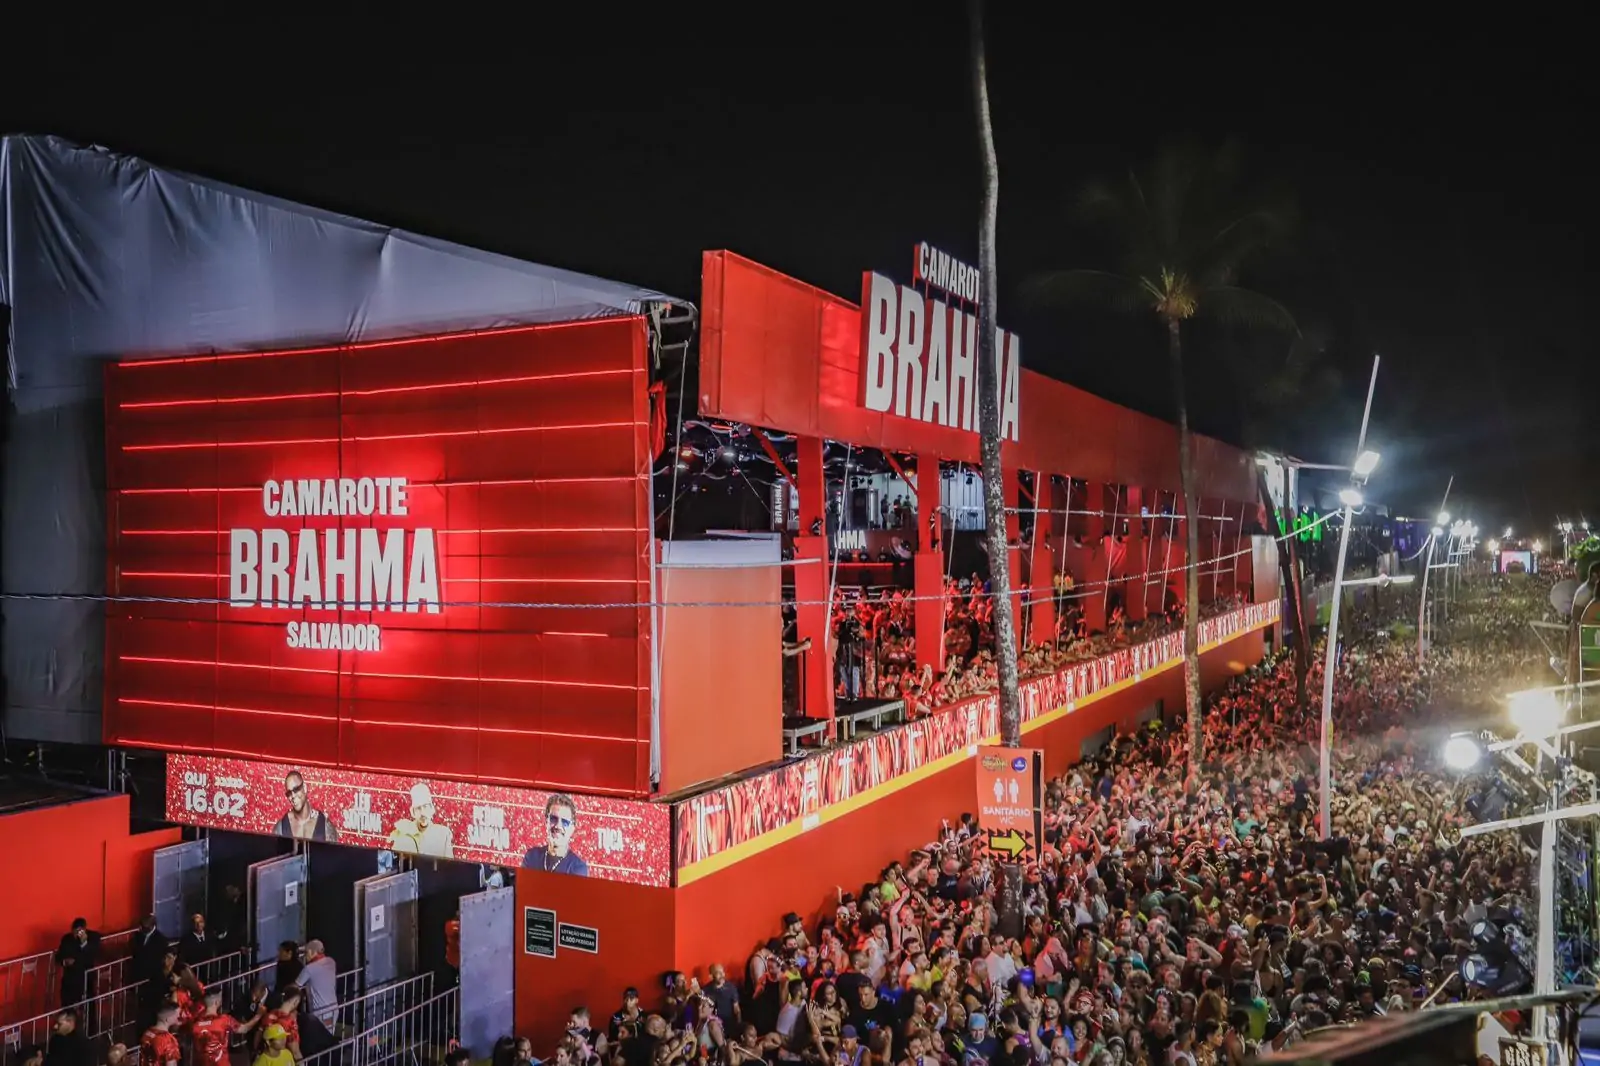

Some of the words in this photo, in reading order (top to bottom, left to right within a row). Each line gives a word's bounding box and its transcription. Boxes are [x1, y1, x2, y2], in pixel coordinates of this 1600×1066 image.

[920, 240, 980, 304] CAMAROT
[865, 270, 1019, 442] BRAHA
[263, 477, 408, 517] CAMAROTE
[230, 528, 441, 614] BRAHMA
[287, 621, 381, 651] SALVADOR
[185, 771, 207, 787] QUI
[185, 788, 246, 818] 16.02
